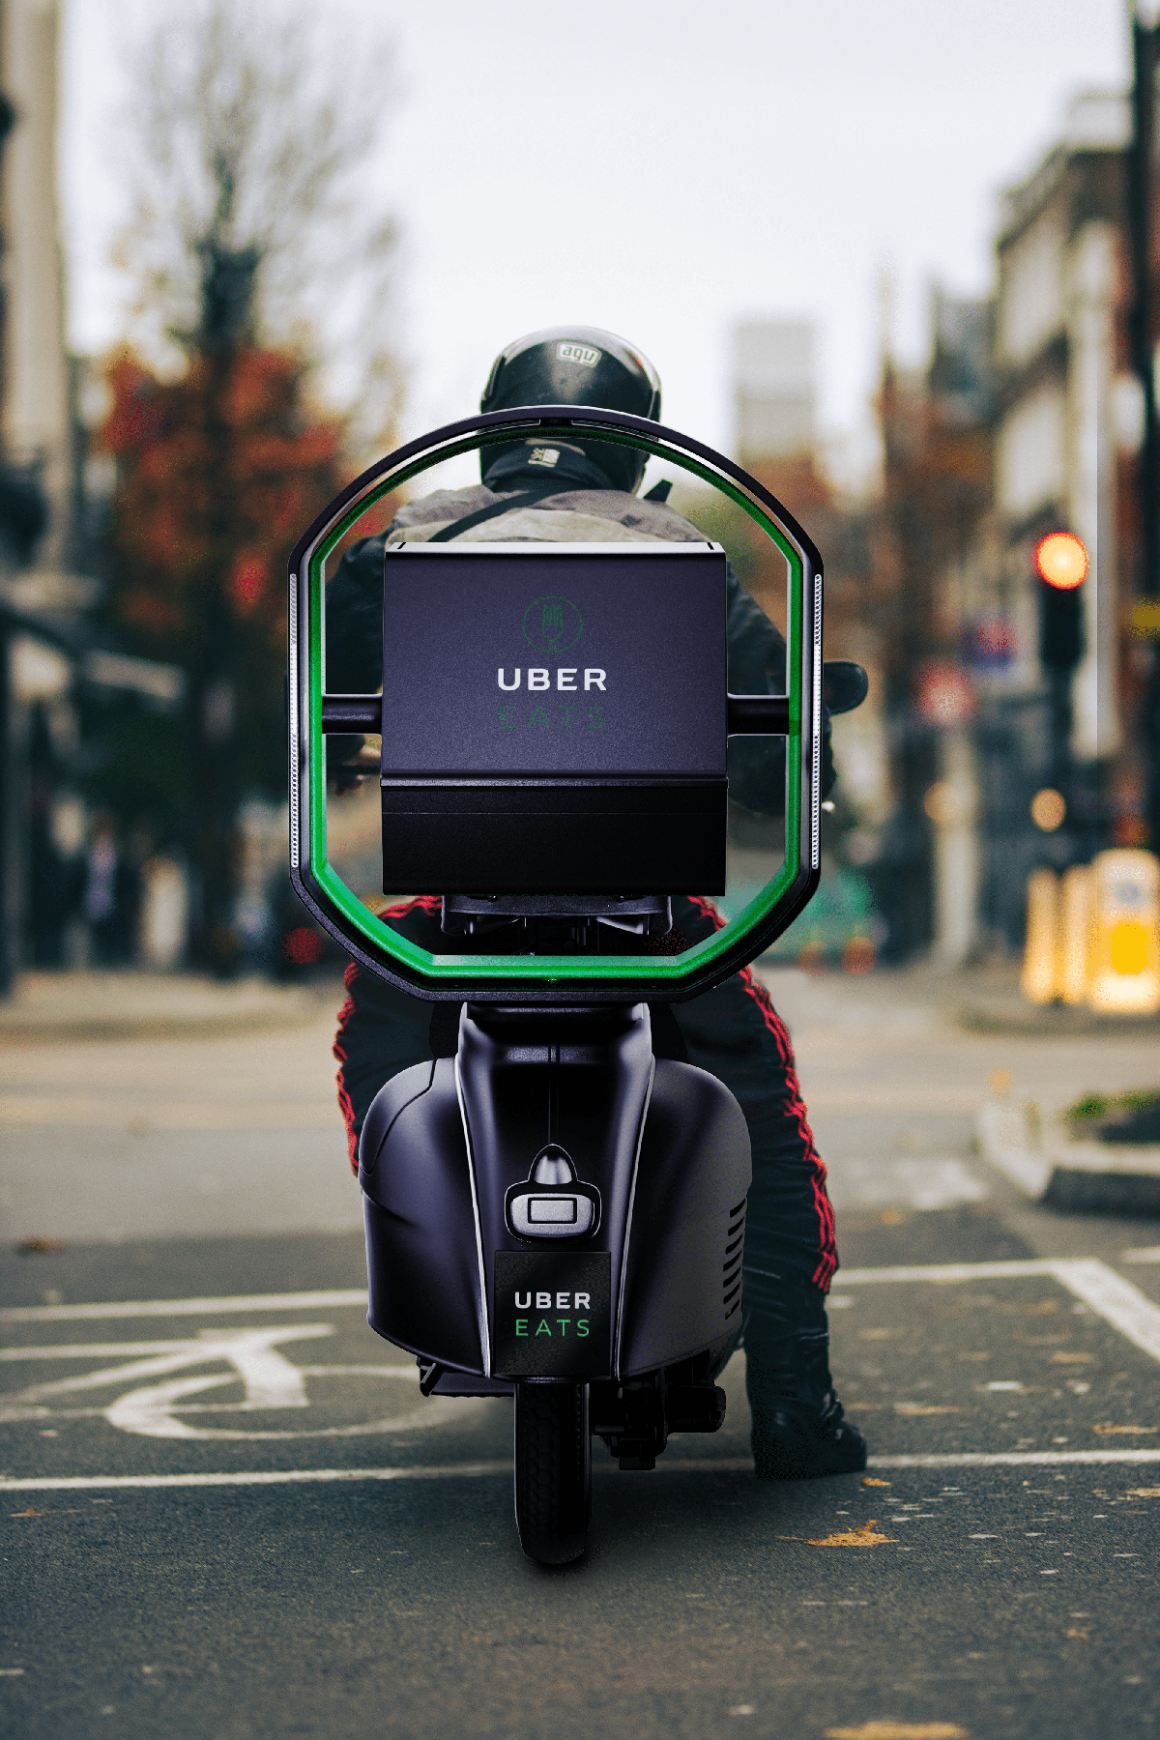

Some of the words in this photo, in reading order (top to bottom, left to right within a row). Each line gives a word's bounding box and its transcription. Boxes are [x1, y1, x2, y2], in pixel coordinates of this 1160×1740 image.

[497, 668, 607, 691] UBER
[499, 706, 605, 729] EATS
[514, 1291, 591, 1310] UBER
[515, 1318, 590, 1337] EATS
